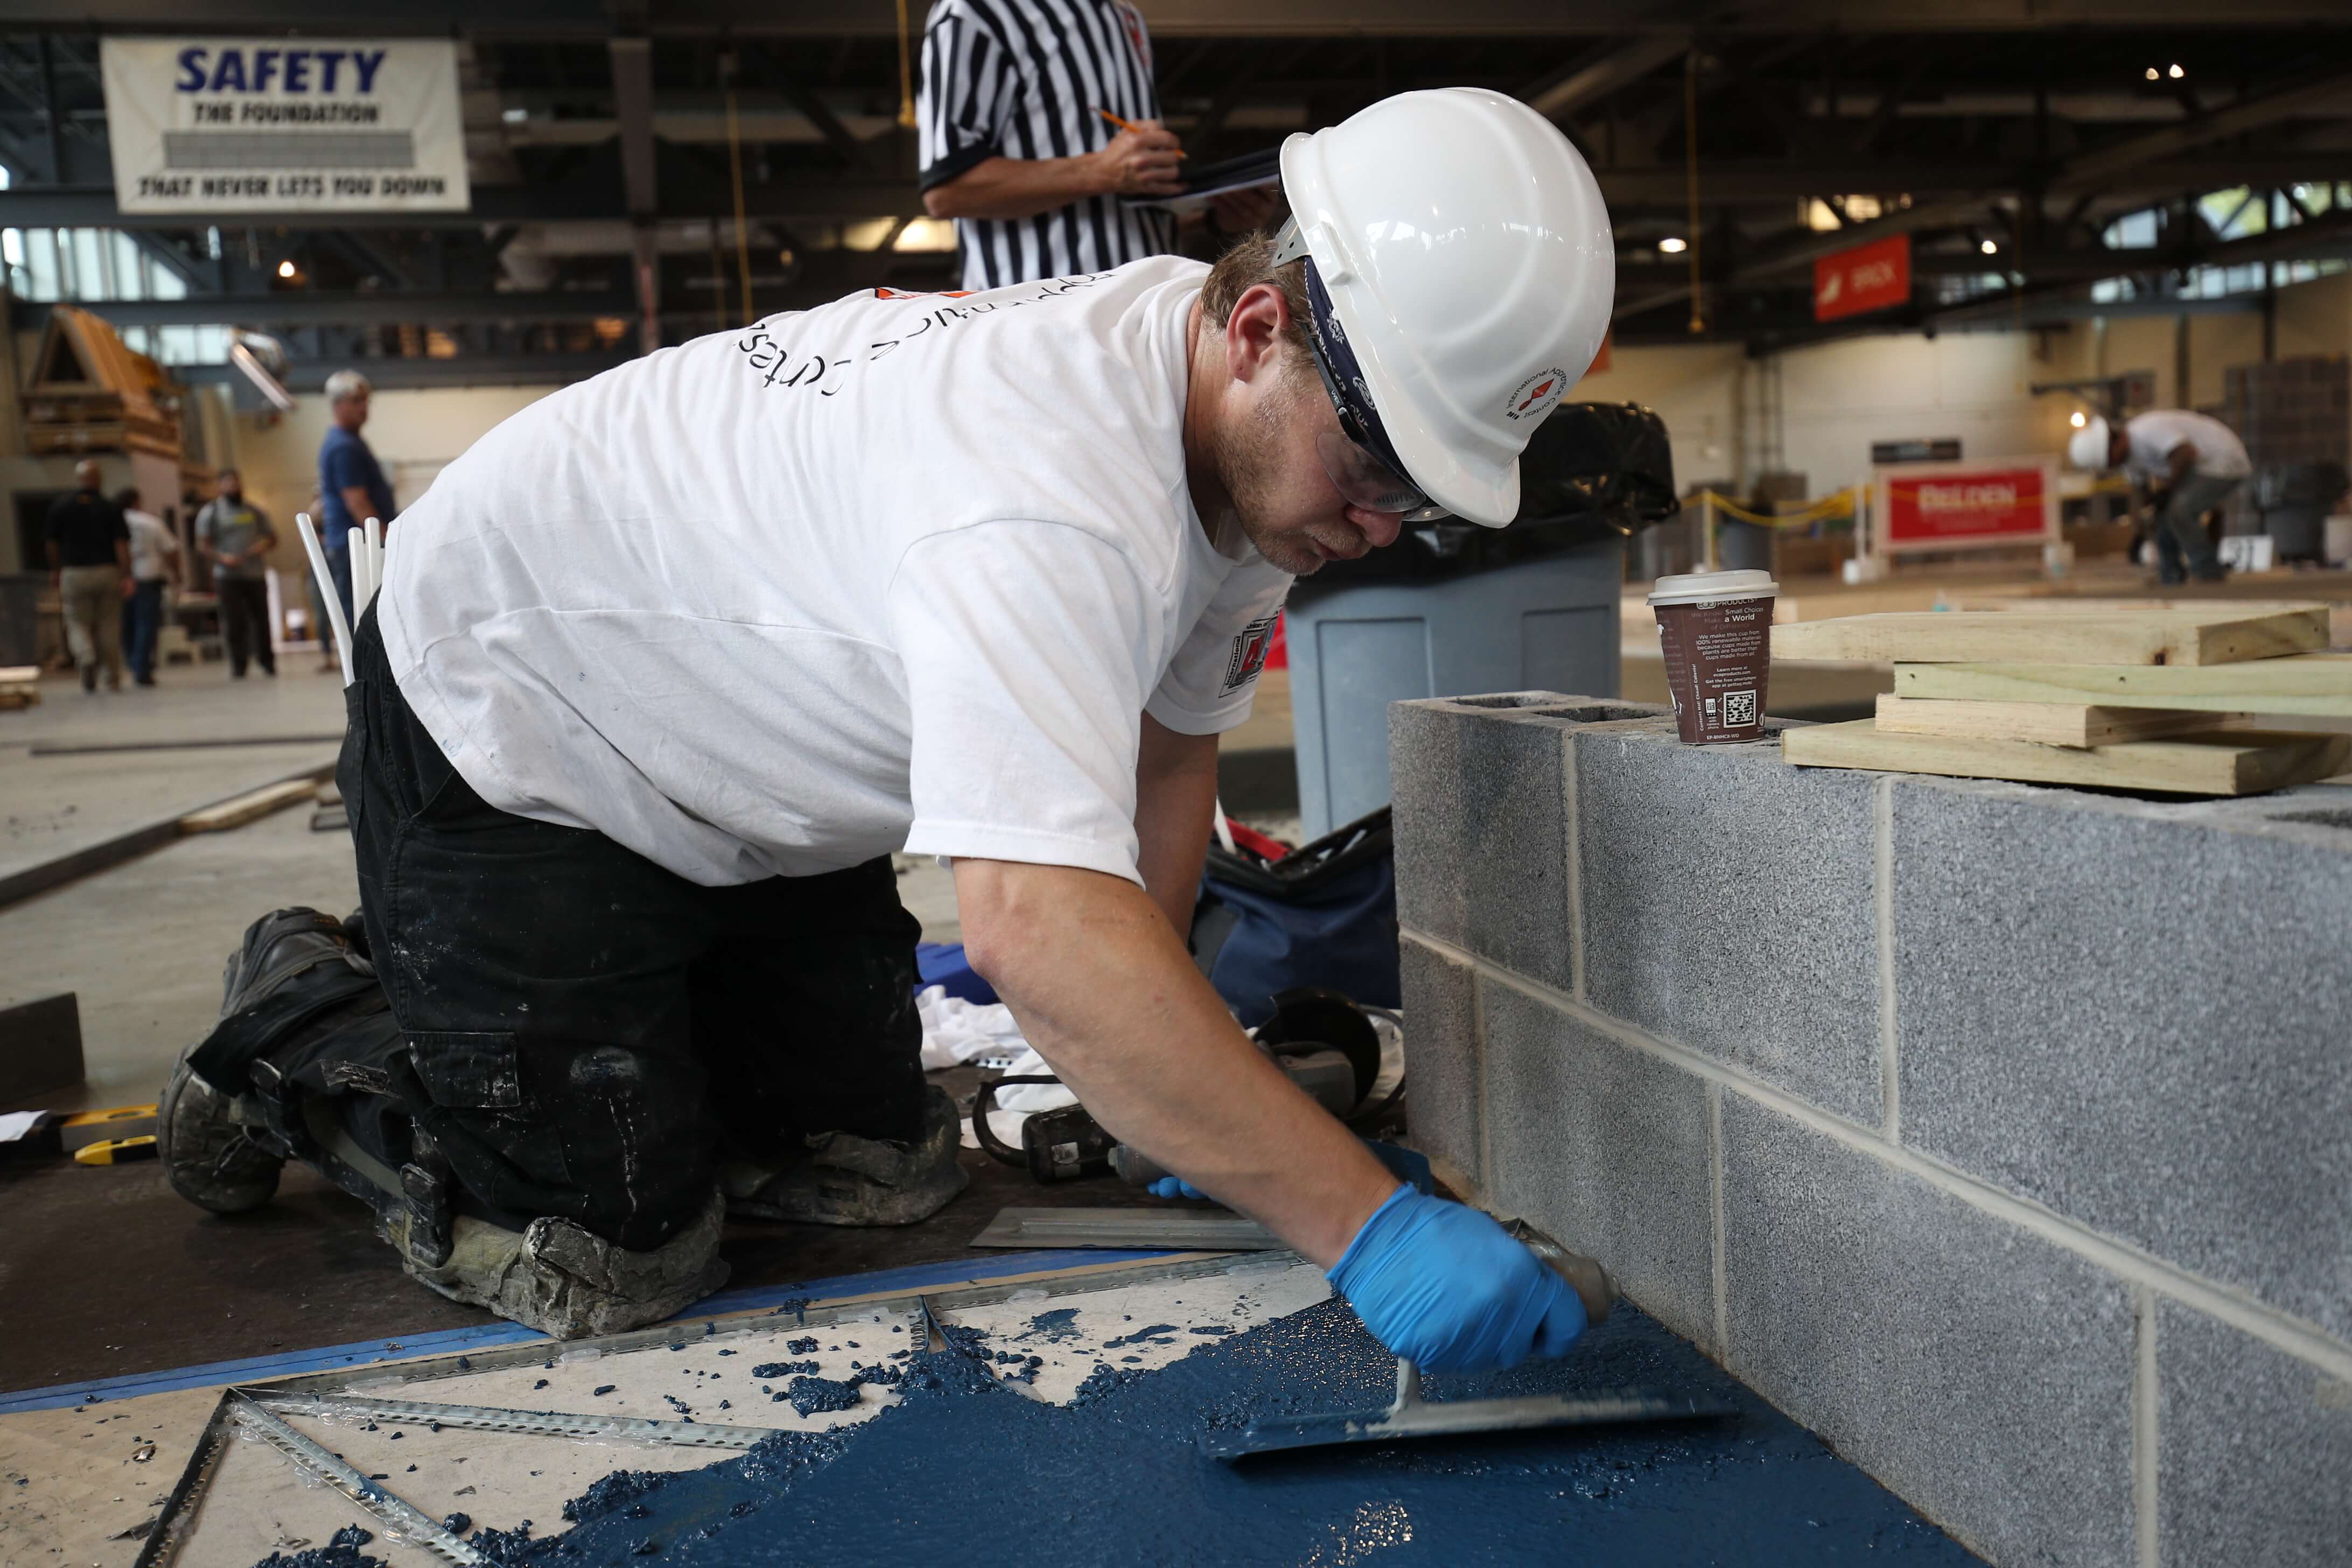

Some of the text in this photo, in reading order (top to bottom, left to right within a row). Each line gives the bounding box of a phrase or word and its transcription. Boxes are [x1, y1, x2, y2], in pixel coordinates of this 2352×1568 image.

[176, 48, 388, 94] SAFETY
[194, 102, 380, 123] THE FOUNDATION
[139, 177, 446, 197] THAT NEVER LETS YOU DOWN
[870, 274, 1117, 360] ppntice
[1506, 367, 1567, 418] International Apprentice Contest
[1732, 613, 1755, 621] World
[1224, 636, 1241, 685] International
